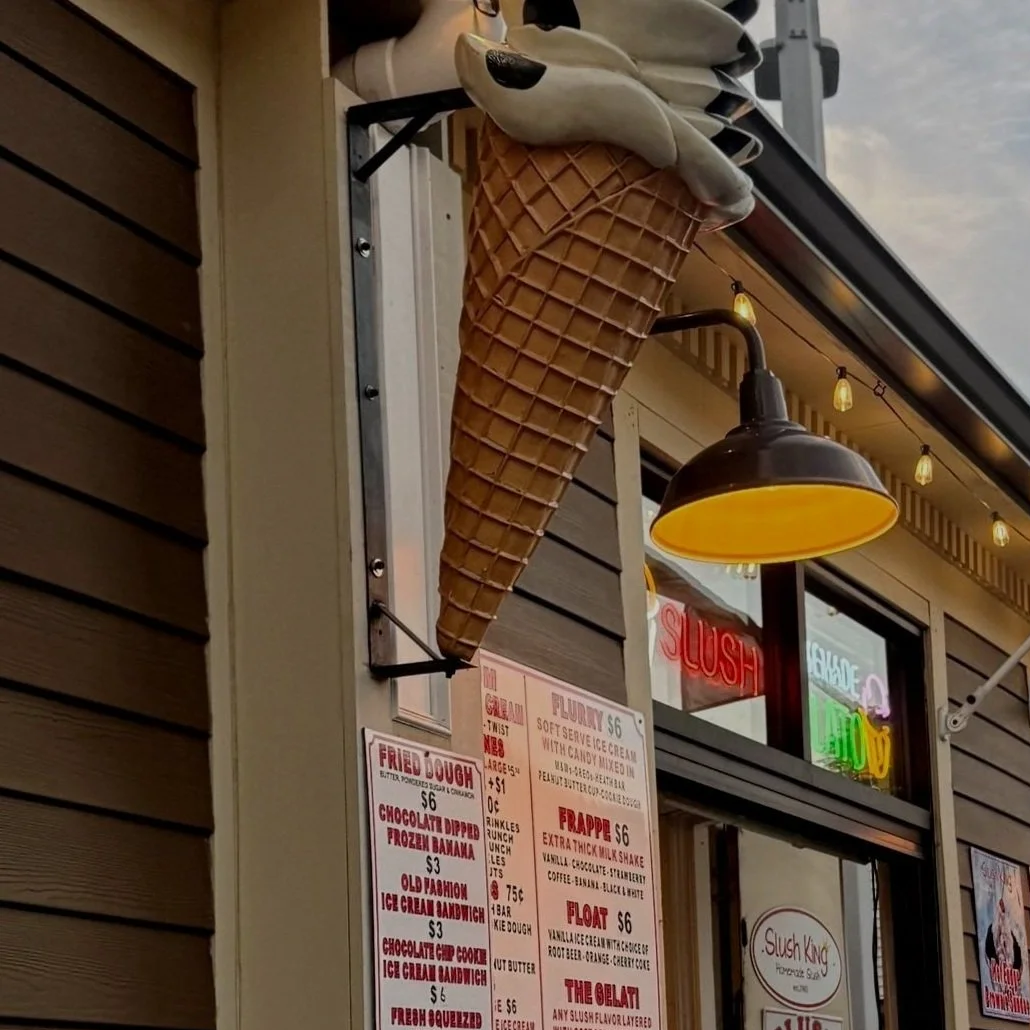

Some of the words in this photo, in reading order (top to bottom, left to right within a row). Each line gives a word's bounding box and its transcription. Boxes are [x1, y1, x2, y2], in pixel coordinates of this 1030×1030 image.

[660, 603, 758, 696] SLUSH
[488, 720, 509, 737] TWIST
[552, 692, 604, 732] FLURRY
[608, 715, 622, 739] $6
[537, 717, 561, 735] SOFT
[563, 725, 591, 747] SERVE
[593, 738, 607, 753] ICE
[608, 743, 637, 763] CREAM
[378, 743, 421, 776] FRIED
[426, 754, 474, 790] DOUGH
[541, 736, 566, 755] WITH
[568, 746, 597, 766] CANDY
[599, 755, 625, 775] MIXED
[627, 767, 635, 779] IN
[421, 791, 436, 811] $6
[378, 803, 442, 833] CHOCOLATE
[444, 816, 480, 840] DIPPED
[558, 806, 611, 842] FRAPPE
[615, 823, 629, 847] $6
[387, 828, 429, 852] FROZEN
[432, 836, 475, 860] BANANA
[543, 832, 571, 850] EXTRA
[573, 839, 597, 856] THICK
[599, 846, 617, 860] MILK
[619, 850, 644, 868] SHAKE
[426, 855, 440, 874] $3
[401, 874, 422, 892] OLD
[424, 878, 467, 900] FASHION
[507, 884, 524, 906] 75¢
[382, 892, 398, 911] ICE
[401, 895, 434, 917] CREAM
[436, 900, 485, 923] SANDWICH
[566, 900, 608, 930] FLOAT
[618, 910, 632, 934] $6
[429, 920, 443, 939] $3
[382, 937, 434, 959] CHOCOLATE
[436, 944, 455, 961] CHIP
[456, 946, 487, 965] COOKIE
[765, 928, 800, 960] Slush
[804, 934, 829, 976] King
[383, 960, 400, 979] ICE
[402, 962, 435, 981] CREAM
[438, 965, 487, 986] SANDWICH
[565, 978, 592, 1005] THE
[595, 982, 640, 1009] GELATI
[391, 1008, 426, 1026] FRESH
[429, 1009, 482, 1029] SQUEEZED
[553, 1009, 567, 1021] ANY
[570, 1011, 593, 1024] SLUSH
[595, 1012, 621, 1026] FLAVOR
[623, 1015, 651, 1028] LAYERED
